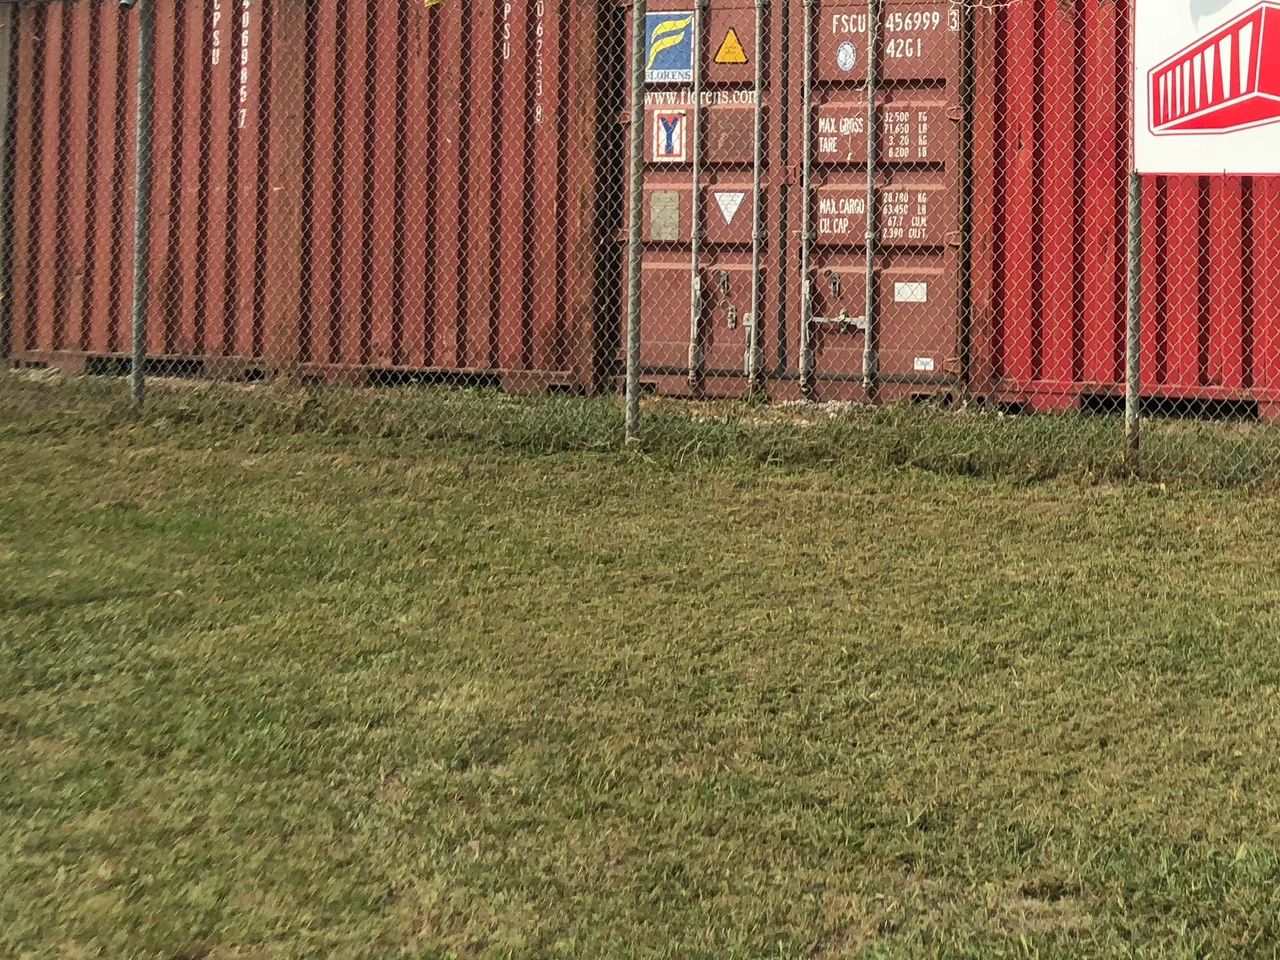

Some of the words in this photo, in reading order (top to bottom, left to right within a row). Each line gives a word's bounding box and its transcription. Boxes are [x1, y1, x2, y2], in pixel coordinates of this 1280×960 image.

[832, 14, 866, 34] FSCU
[885, 11, 940, 32] 456999
[949, 10, 958, 31] 3
[886, 37, 921, 58] 42G1
[840, 117, 864, 133] GROSS
[819, 137, 837, 153] TARE
[840, 199, 865, 214] CARGO
